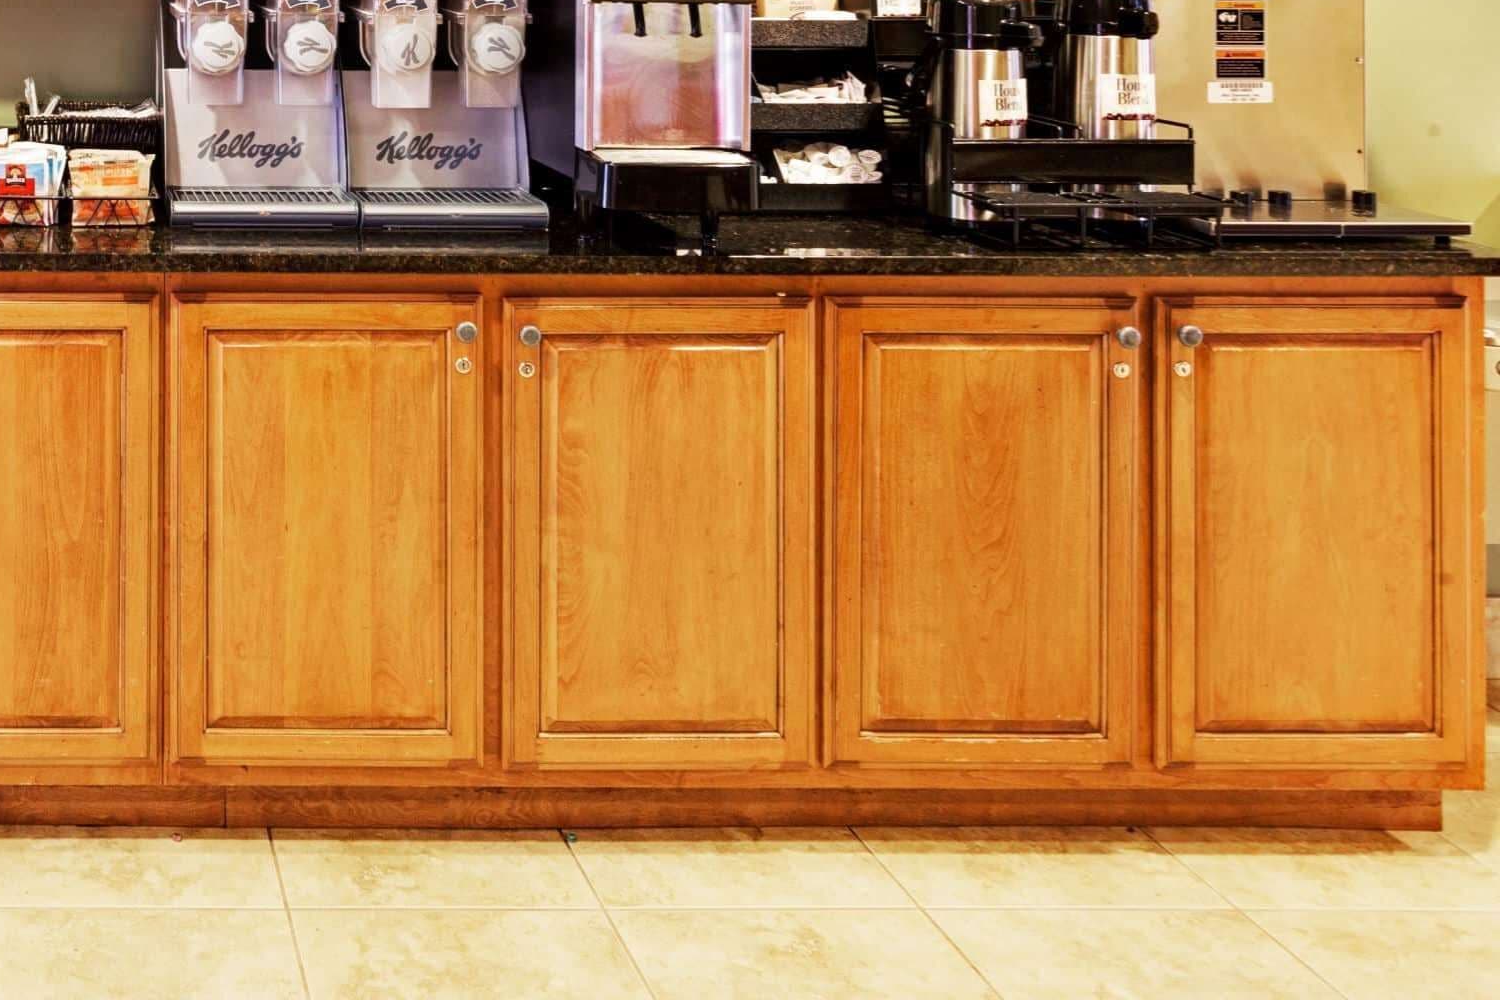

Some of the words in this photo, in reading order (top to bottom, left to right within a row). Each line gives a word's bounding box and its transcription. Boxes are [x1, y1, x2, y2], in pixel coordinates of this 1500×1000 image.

[995, 97, 1025, 111] Blen
[198, 128, 303, 168] Kellogg's
[376, 131, 484, 170] Kellogg's
